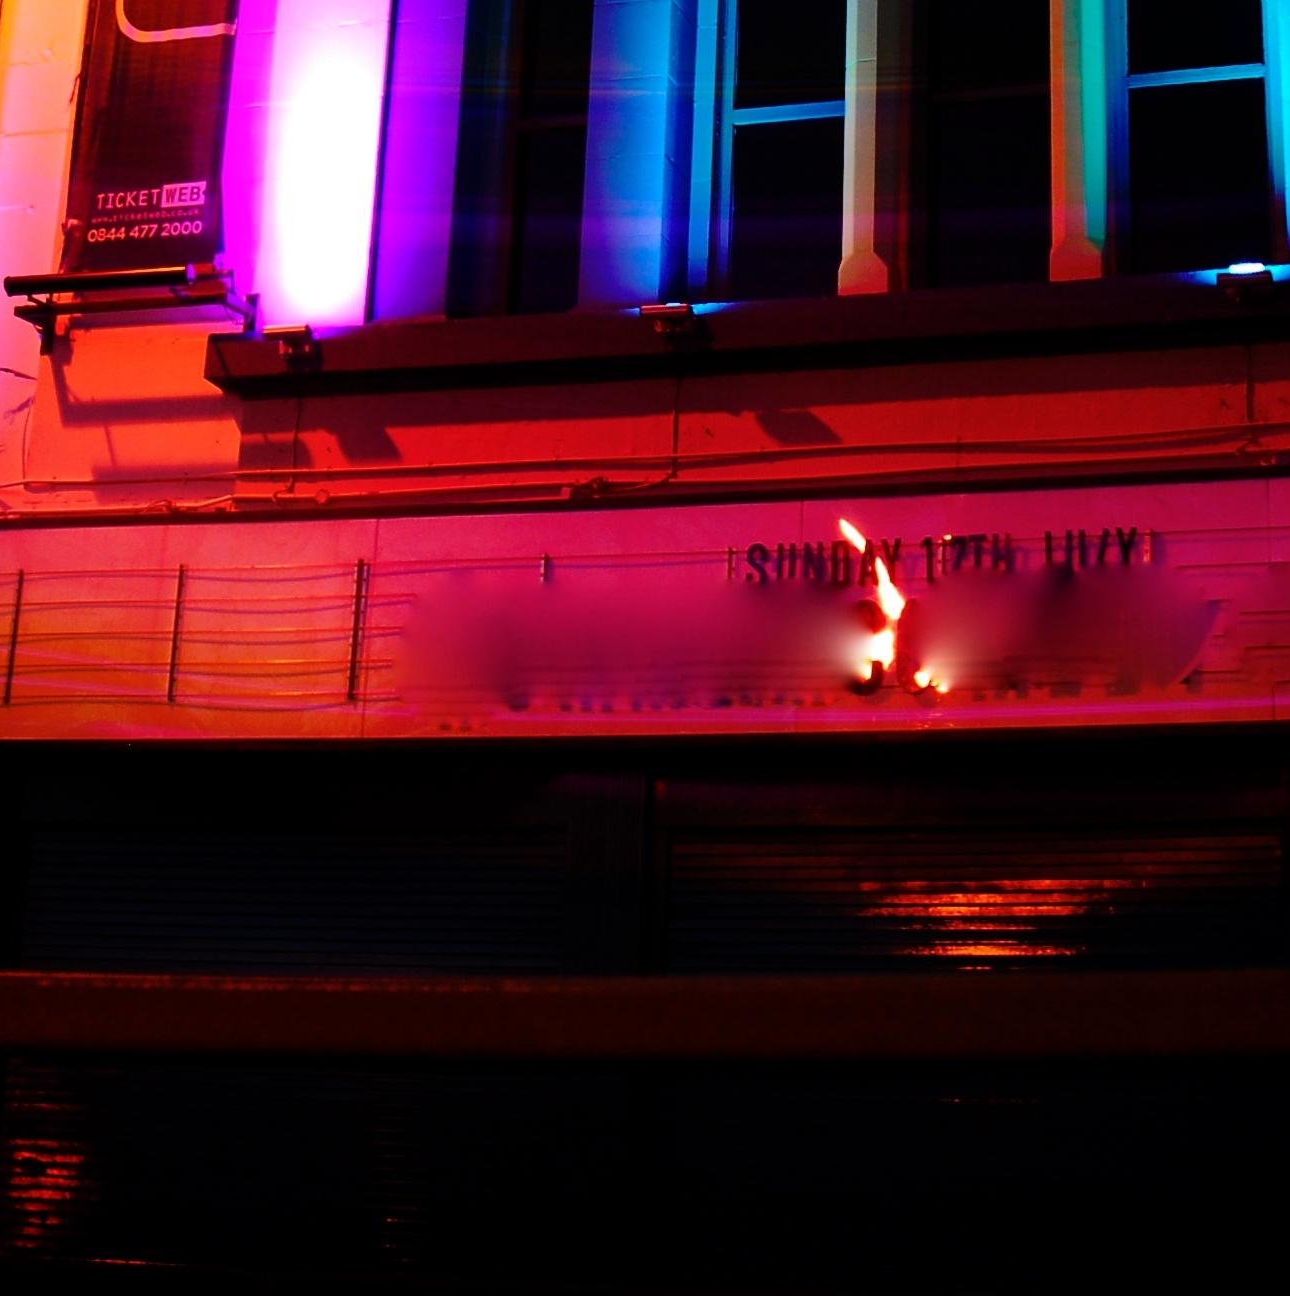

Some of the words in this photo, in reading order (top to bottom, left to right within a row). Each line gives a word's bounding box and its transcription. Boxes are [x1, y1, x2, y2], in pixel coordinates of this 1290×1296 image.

[87, 227, 126, 243] 0844
[129, 224, 159, 240] 477
[160, 220, 203, 237] 2000
